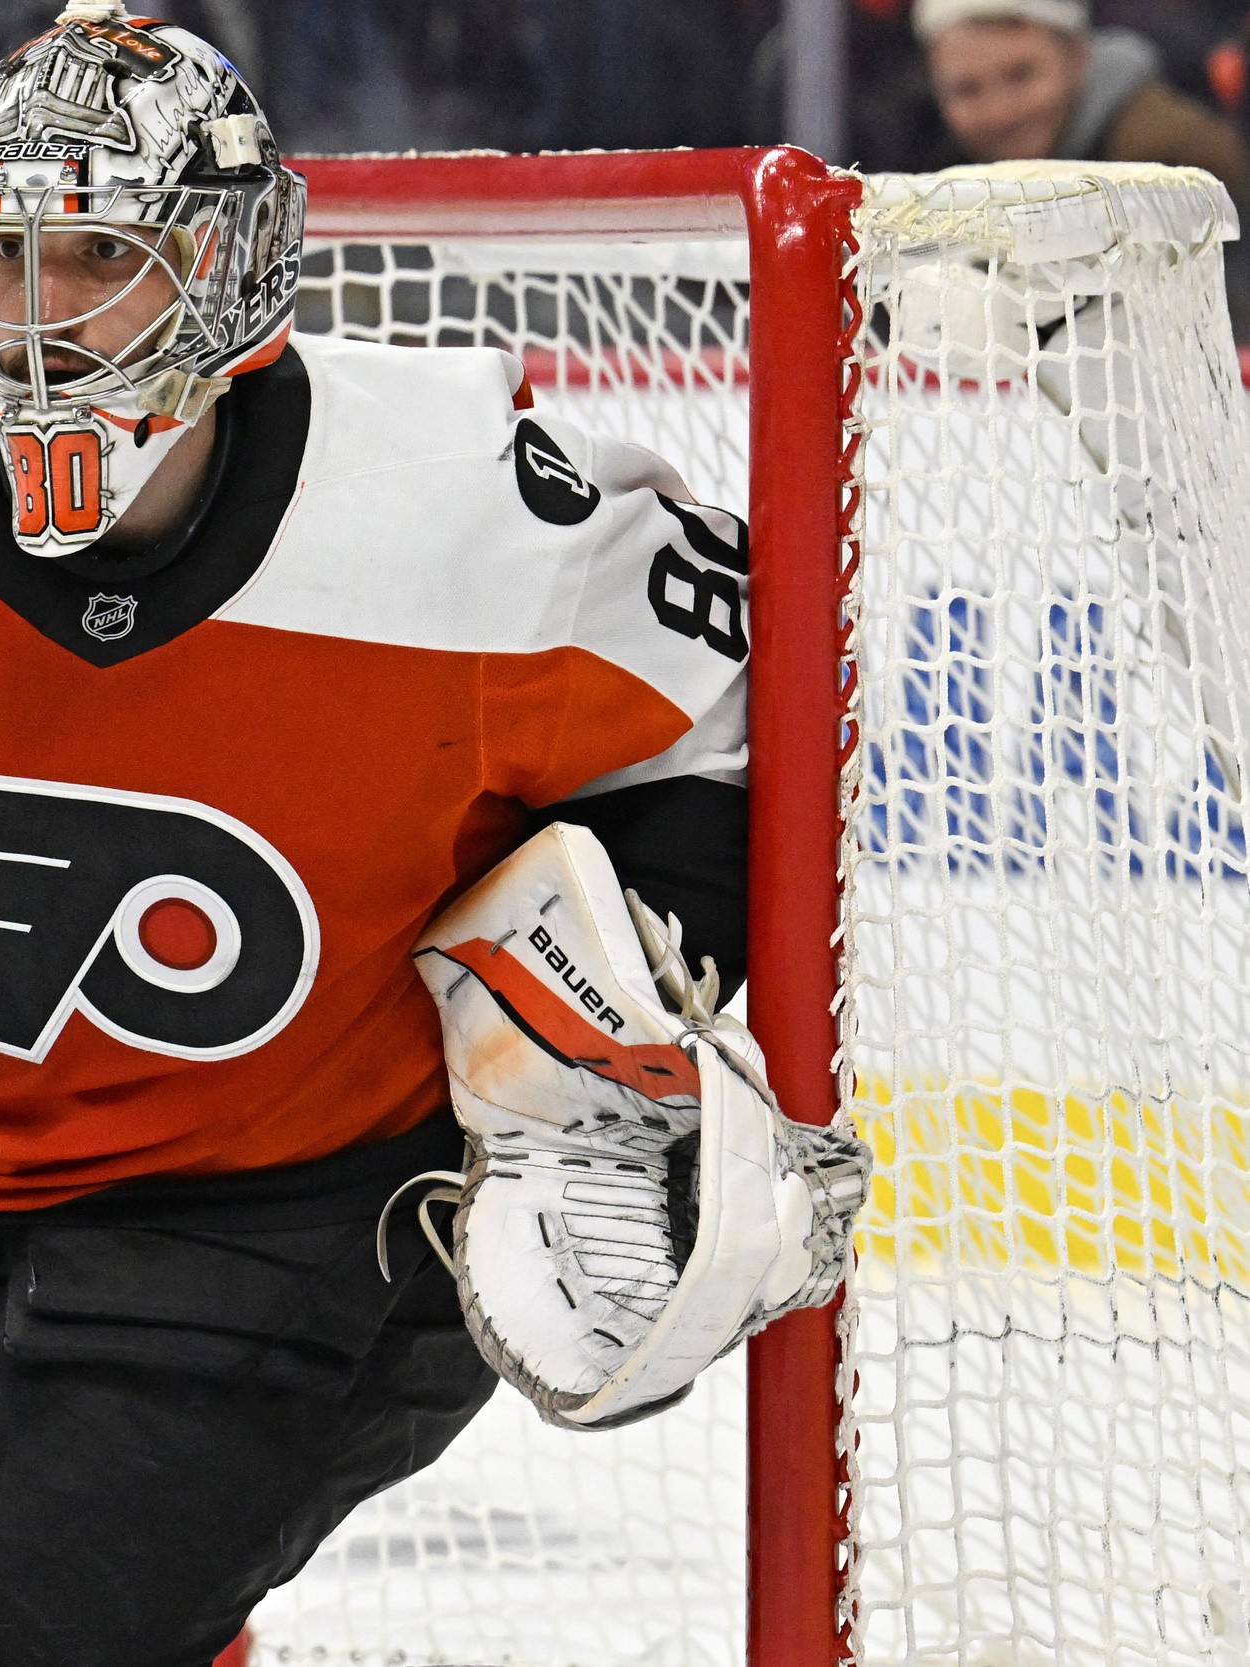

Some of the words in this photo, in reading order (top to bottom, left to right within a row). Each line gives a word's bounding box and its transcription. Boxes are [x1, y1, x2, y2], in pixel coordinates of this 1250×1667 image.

[5, 429, 102, 537] 80
[93, 607, 127, 628] NHL
[528, 925, 625, 1034] BAUER
